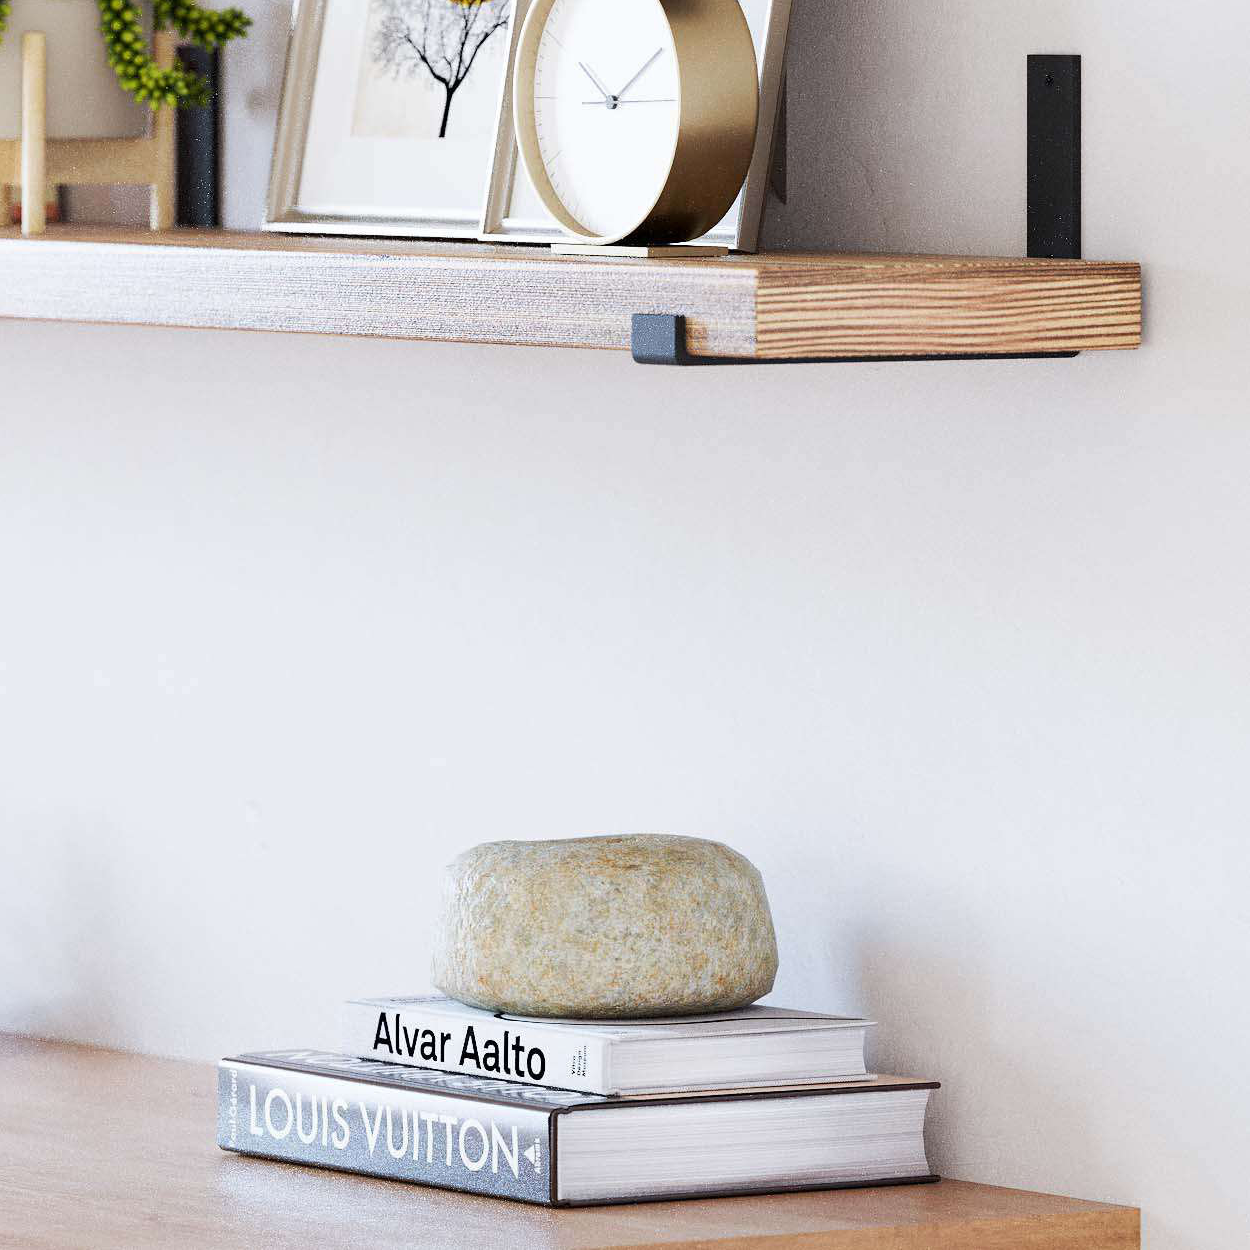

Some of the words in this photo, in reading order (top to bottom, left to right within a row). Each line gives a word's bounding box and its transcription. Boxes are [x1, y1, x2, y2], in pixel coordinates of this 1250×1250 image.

[372, 1011, 452, 1063] Alvar
[458, 1025, 546, 1081] Aalto
[250, 1085, 351, 1151] LOUIS
[358, 1100, 519, 1180] VUITTON
